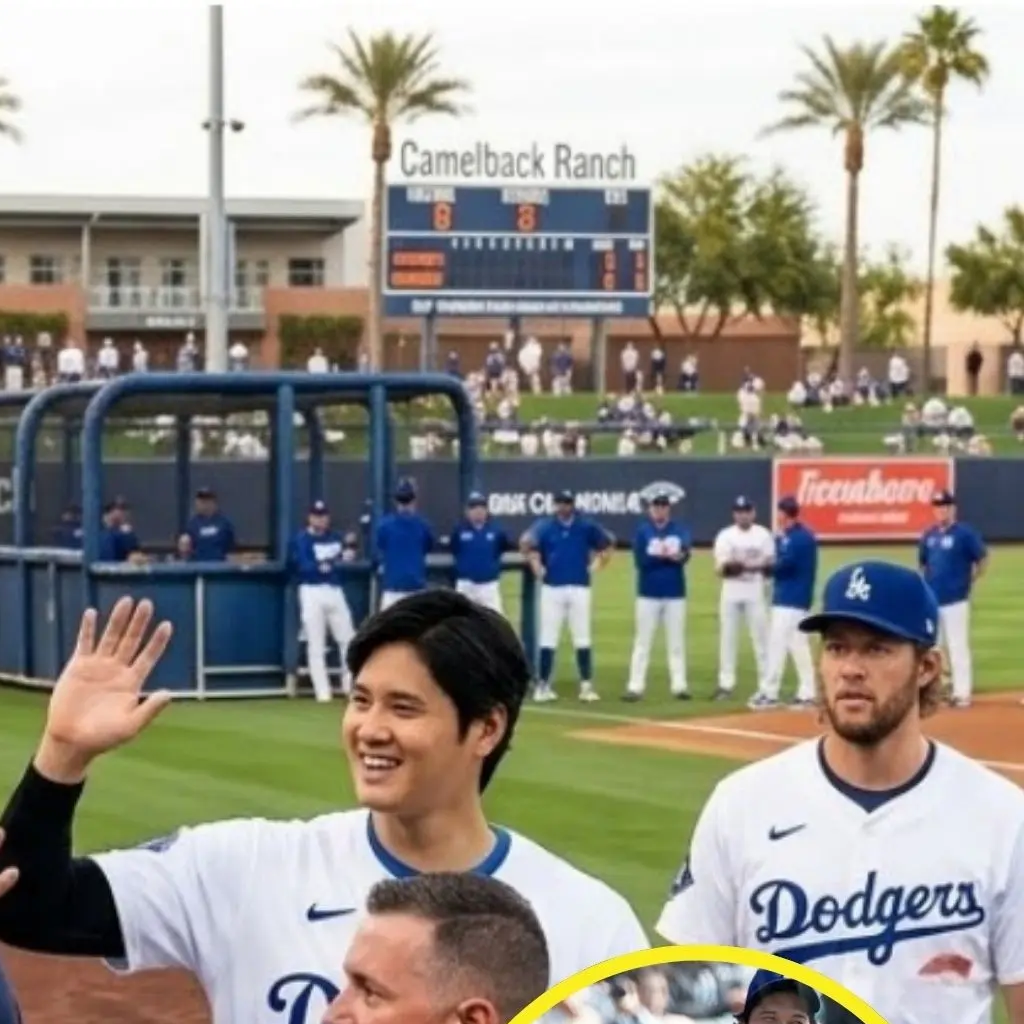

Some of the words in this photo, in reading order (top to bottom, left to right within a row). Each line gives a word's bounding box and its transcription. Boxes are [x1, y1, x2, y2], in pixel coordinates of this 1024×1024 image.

[400, 140, 545, 179] Camelback
[553, 142, 636, 180] Ranch
[750, 870, 984, 966] Dodgers
